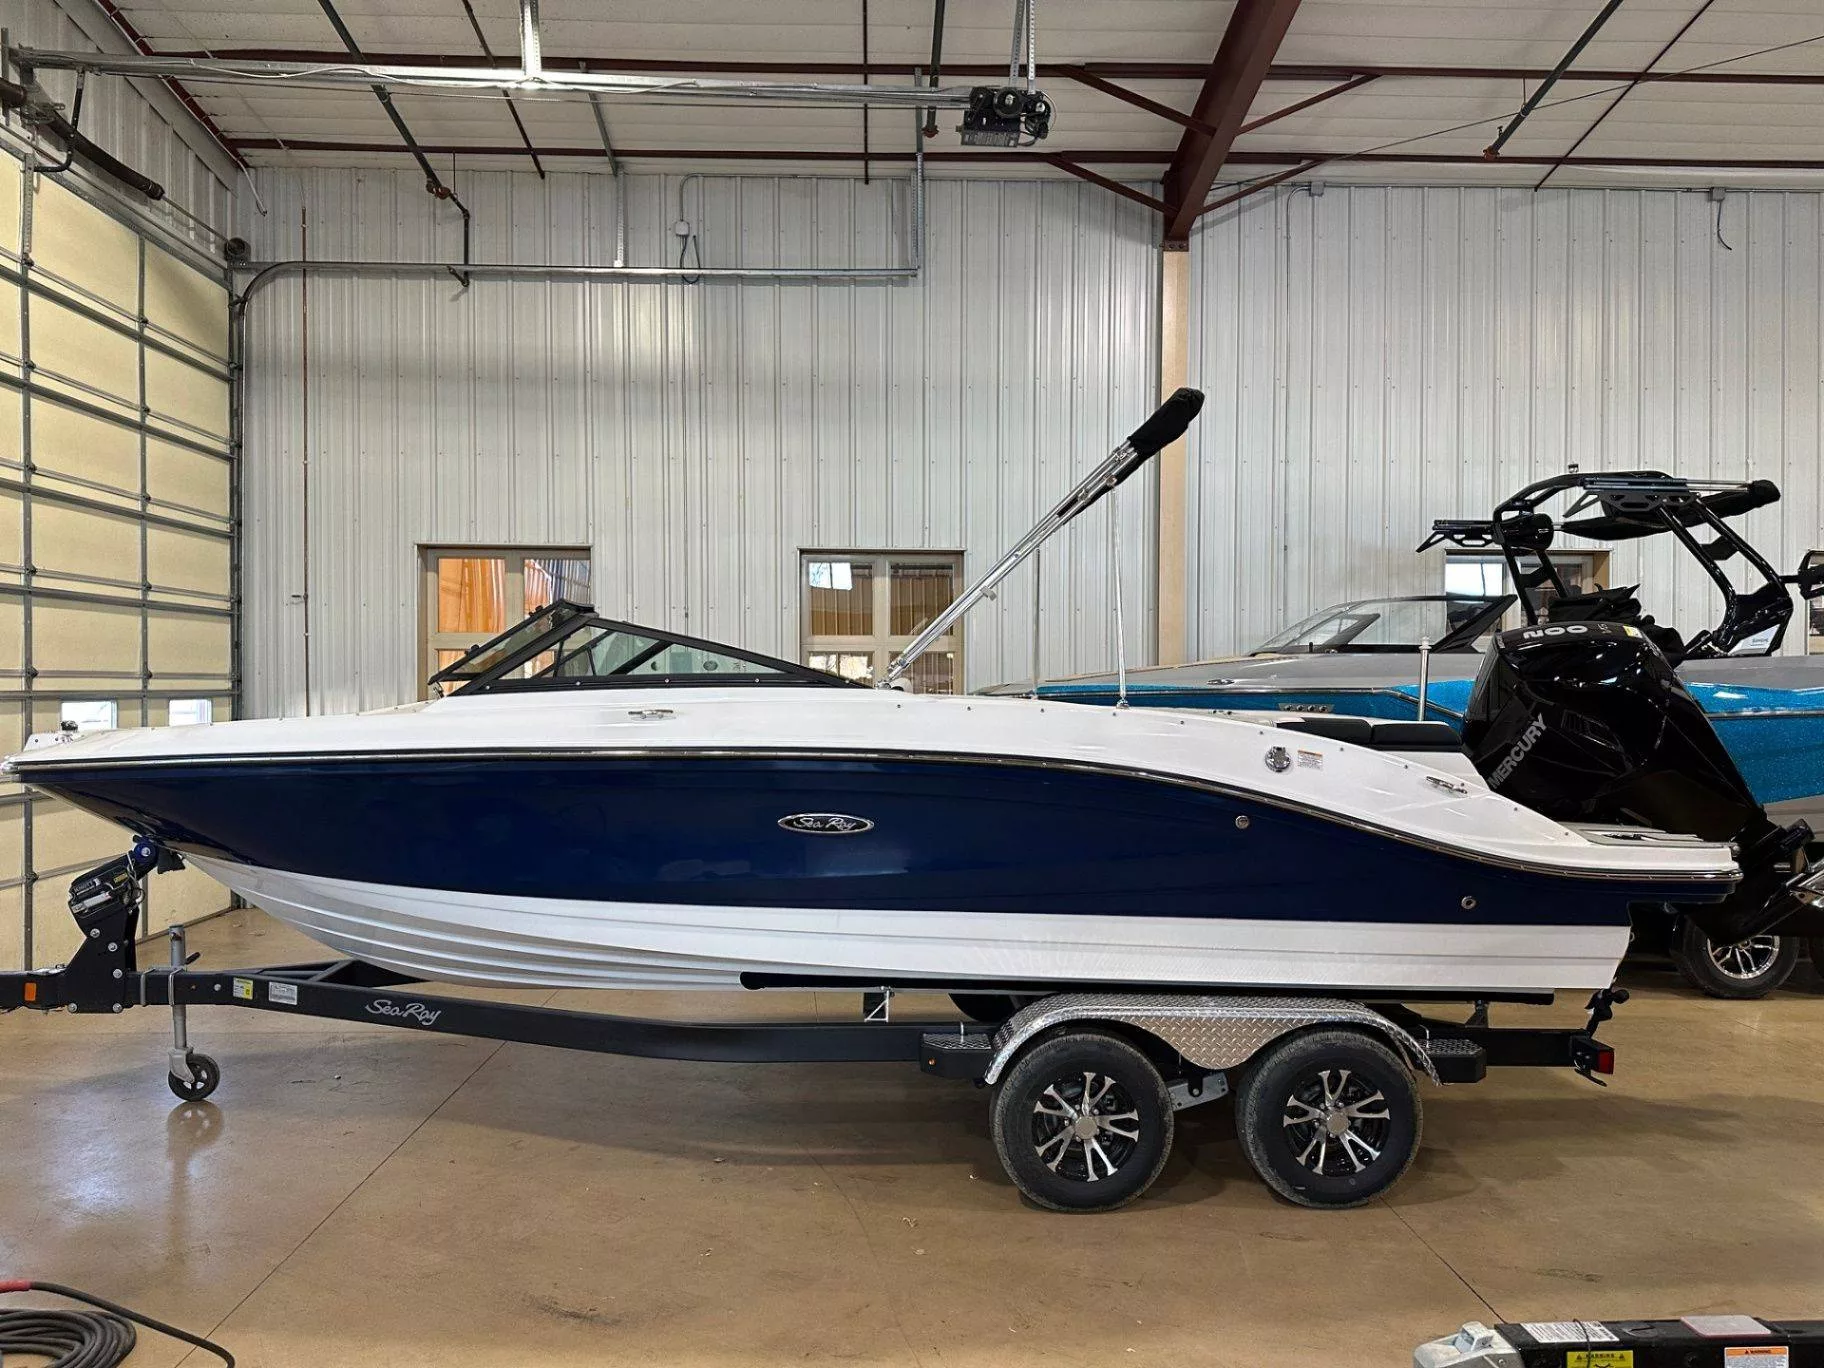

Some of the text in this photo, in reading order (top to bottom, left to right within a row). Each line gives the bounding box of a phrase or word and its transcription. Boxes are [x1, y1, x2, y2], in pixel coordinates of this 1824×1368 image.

[1523, 625, 1588, 639] 200
[1487, 712, 1547, 789] MERCURY
[793, 817, 856, 830] Sea Ray
[365, 999, 442, 1026] Sea Ray
